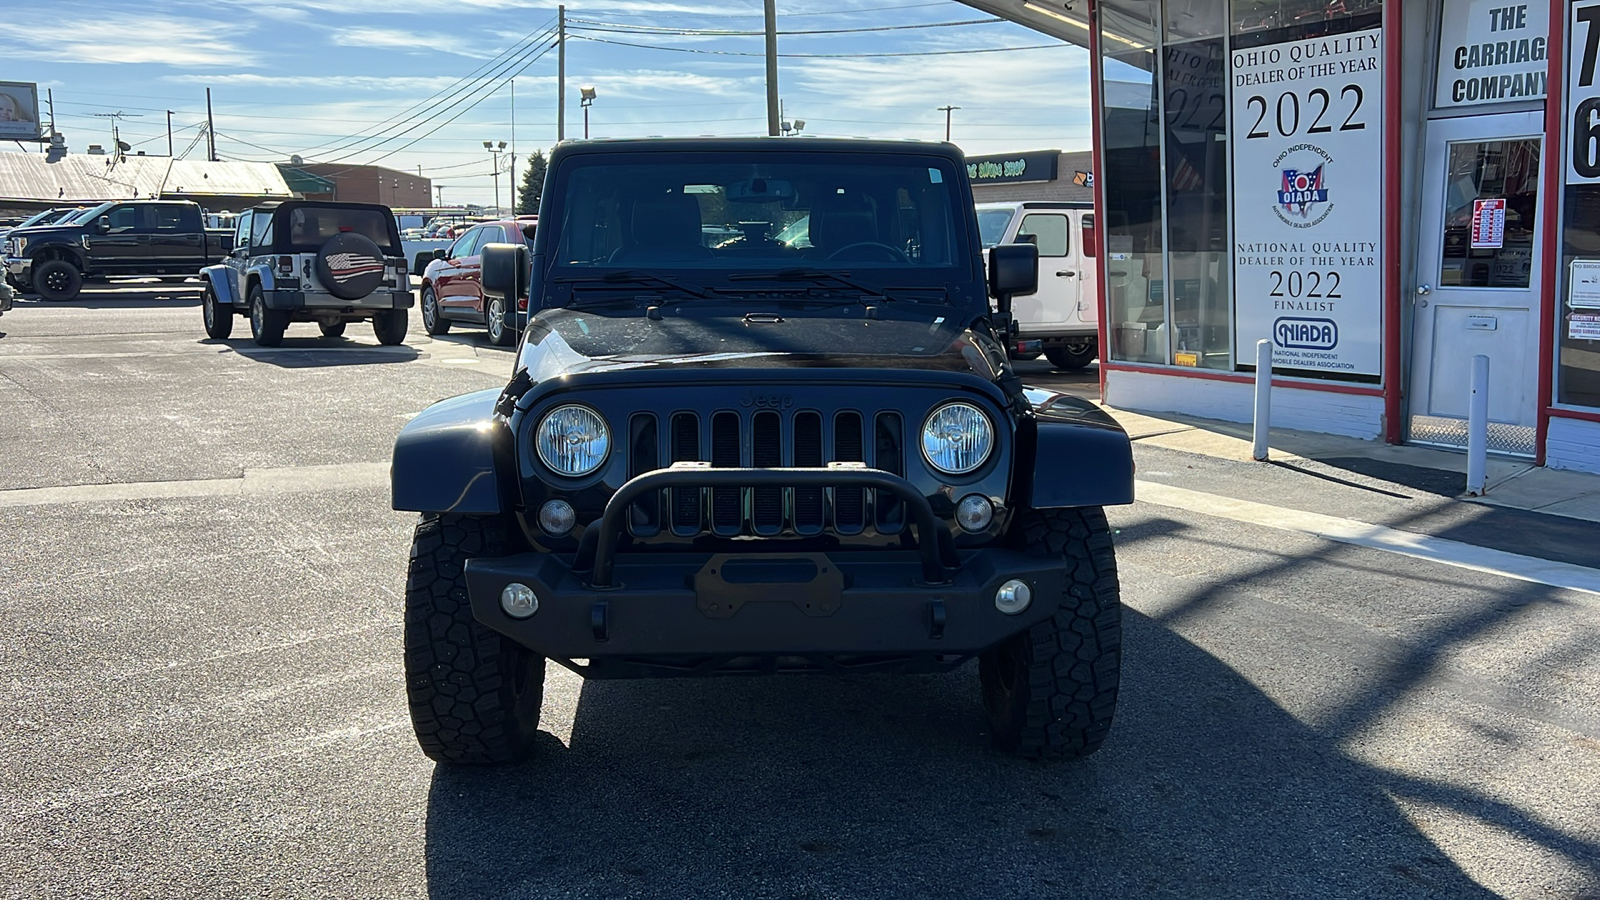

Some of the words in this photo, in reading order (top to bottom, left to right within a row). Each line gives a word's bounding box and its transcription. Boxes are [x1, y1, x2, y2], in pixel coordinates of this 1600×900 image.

[1489, 5, 1527, 32] THE
[1233, 49, 1281, 69] OHIO
[1290, 34, 1380, 63] QUALITY
[1454, 36, 1549, 69] CARRIAG
[1235, 65, 1285, 87] DEALER
[1288, 63, 1306, 80] OF
[1308, 61, 1336, 78] THE
[1339, 57, 1378, 75] YEAR
[1246, 84, 1366, 139] 2022
[1273, 151, 1288, 168] OHIO
[1288, 144, 1334, 164] INDEPENDENT
[1283, 190, 1320, 203] OIADA
[1272, 205, 1293, 226] AUTOMOBILE
[1311, 202, 1335, 226] ASSOCIATION
[1238, 243, 1306, 253] NATIONAL
[1312, 242, 1377, 254] QUALITY
[1239, 256, 1285, 266] DEALER
[1289, 256, 1305, 266] OF
[1310, 256, 1335, 266] THE
[1341, 257, 1375, 266] YEAR
[1269, 271, 1342, 298] 2022
[1274, 301, 1335, 311] FINALIST
[1302, 352, 1338, 360] INDEPENDENT
[1317, 361, 1355, 369] ASSOCIATION
[739, 389, 794, 411] Jeep
